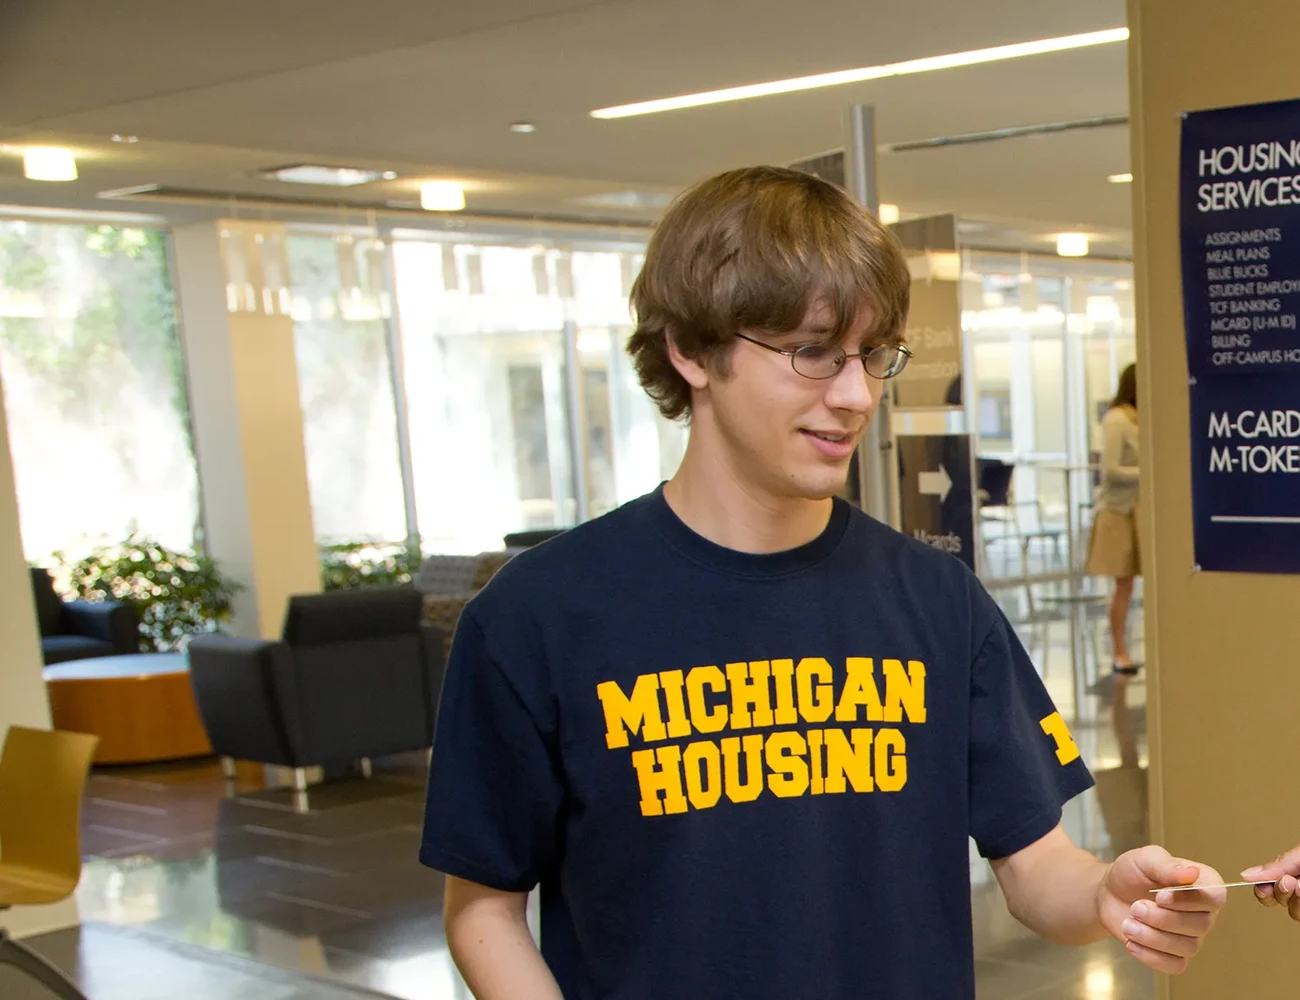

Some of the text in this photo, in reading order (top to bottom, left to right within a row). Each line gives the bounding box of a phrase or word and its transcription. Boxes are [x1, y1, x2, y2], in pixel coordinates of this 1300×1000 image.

[1204, 227, 1281, 246] ASSIGNMENTS
[1206, 246, 1270, 263] MEAL PLANS
[1207, 263, 1269, 280] BLUE BUCKS
[1208, 282, 1255, 298] STUDENT
[1209, 298, 1281, 315] TCF BANKING
[1210, 317, 1251, 331] MCARD
[1211, 333, 1251, 349] BILLING
[1212, 349, 1282, 366] OFF-CAMPUS
[597, 657, 927, 749] MICHIGAN
[632, 728, 908, 816] HOUSING
